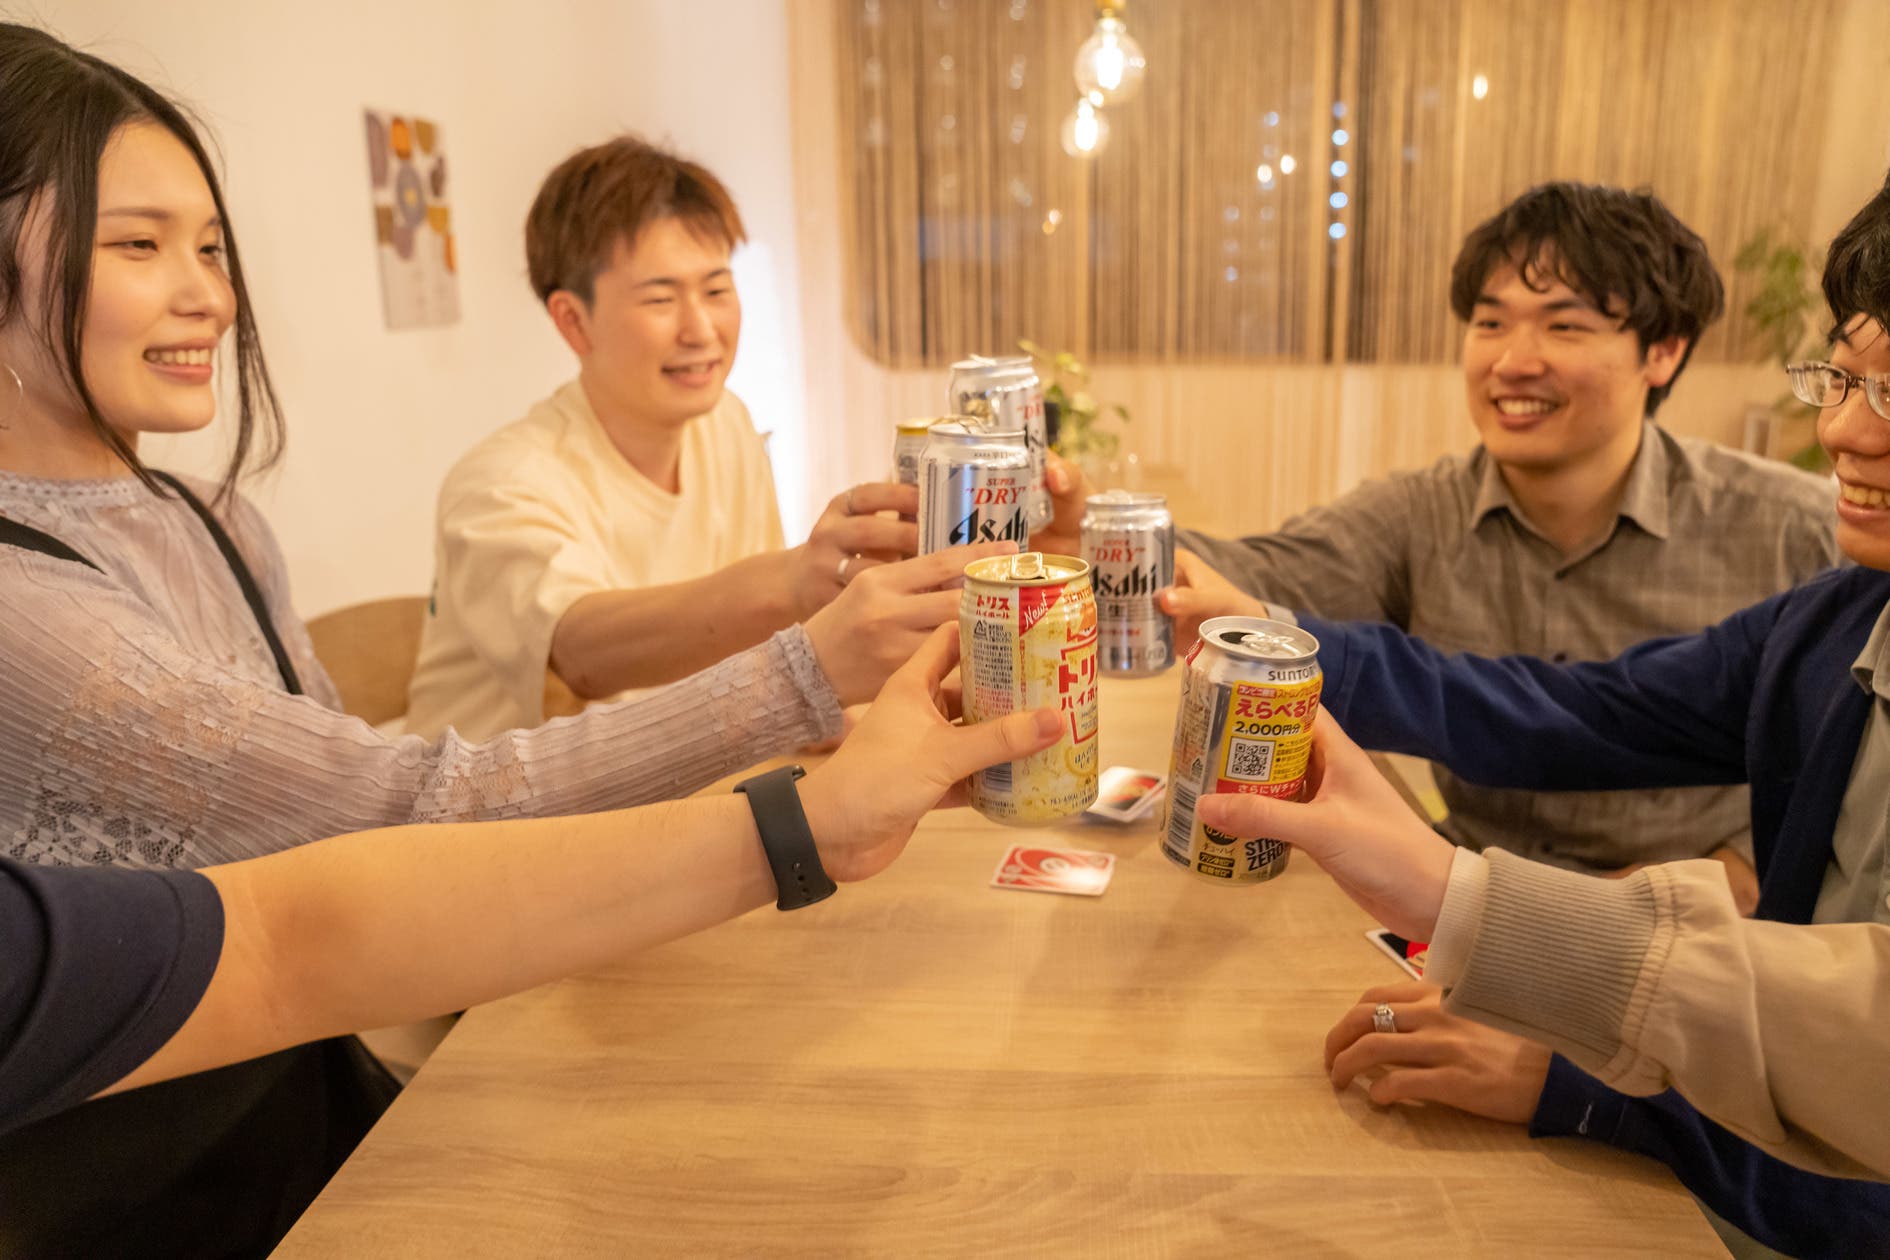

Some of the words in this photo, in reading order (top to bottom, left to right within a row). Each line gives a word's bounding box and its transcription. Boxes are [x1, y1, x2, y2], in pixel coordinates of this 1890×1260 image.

[986, 477, 1016, 487] SUPER
[976, 594, 1010, 610] トリス
[1023, 590, 1049, 629] New!
[976, 609, 1011, 620] ハイボール
[1058, 653, 1095, 694] トリ
[1234, 721, 1301, 735] 2,000円分
[1247, 843, 1284, 871] ZERO
